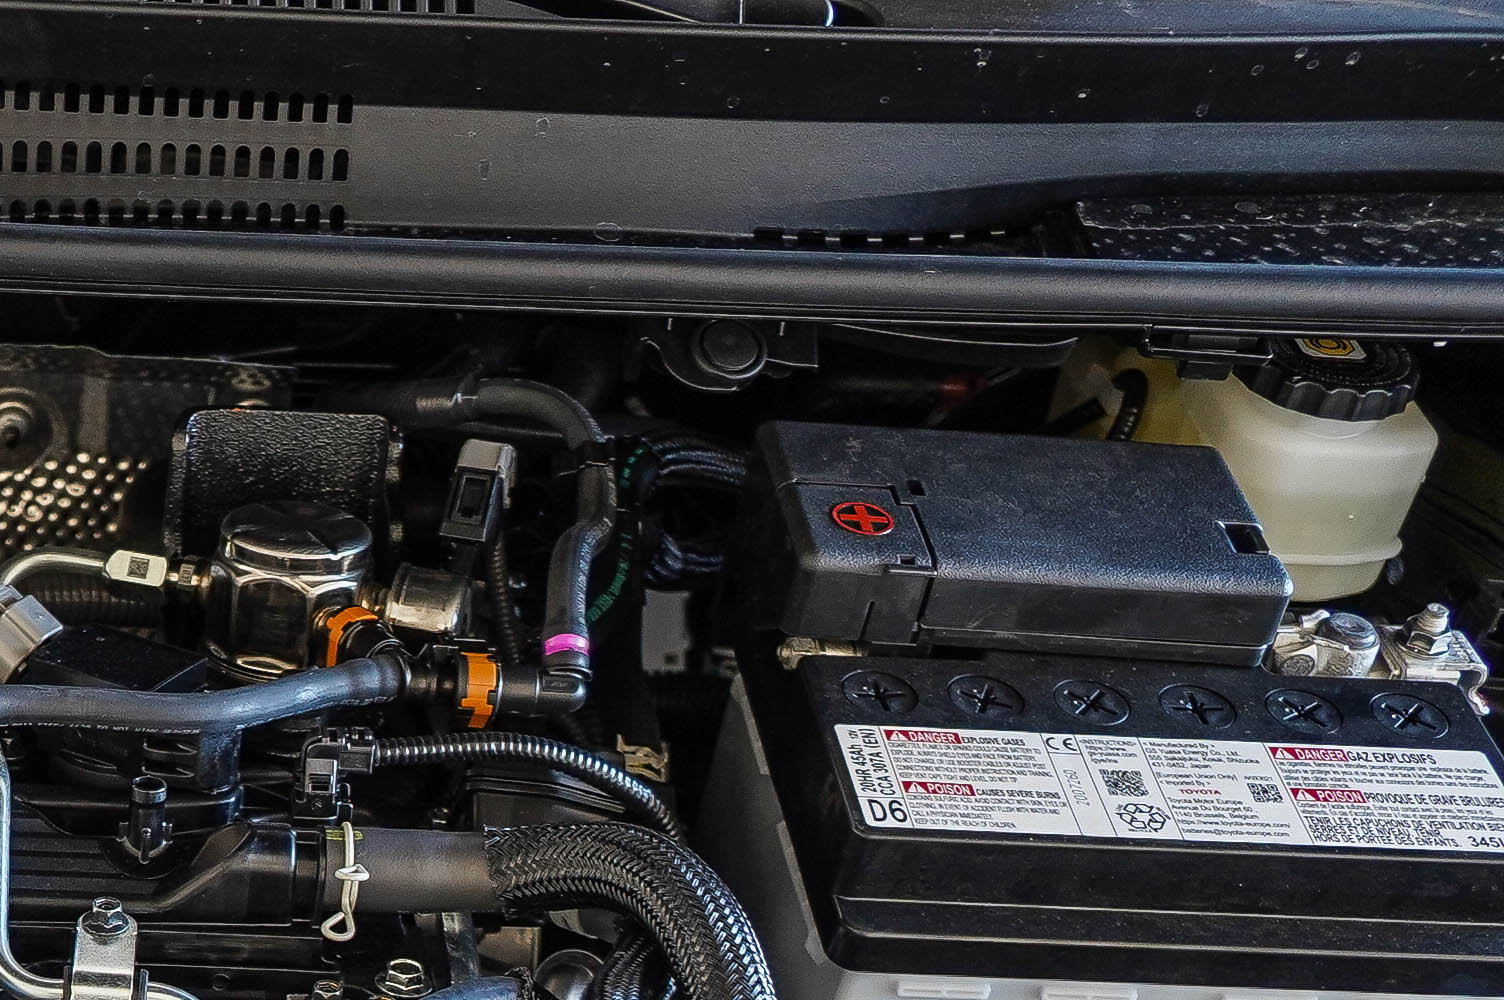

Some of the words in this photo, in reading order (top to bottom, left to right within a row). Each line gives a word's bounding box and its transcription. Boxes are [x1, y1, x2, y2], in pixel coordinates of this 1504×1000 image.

[858, 728, 881, 748] (EN)
[908, 732, 957, 742] DANGER
[847, 744, 868, 767] 45Ah
[1295, 749, 1346, 760] DANGER
[1346, 751, 1373, 761] GAZ
[1372, 752, 1437, 764] EXPLOSIFS
[867, 751, 889, 773] 307A
[855, 769, 876, 793] 20HR
[875, 775, 896, 796] CCA
[926, 783, 972, 795] POISON
[976, 788, 1006, 796] CAUSES
[1317, 791, 1363, 802] POISON
[1364, 792, 1415, 804] PROVOQUE
[1414, 794, 1430, 804] DE
[867, 799, 908, 823] D6
[1304, 816, 1332, 824] TENIR
[1333, 817, 1352, 825] LES
[1352, 818, 1411, 827] CAPUCHONS
[1411, 820, 1426, 828] DE
[1426, 821, 1487, 830] VENTILATION
[1347, 826, 1360, 834] ET
[1313, 833, 1340, 841] HORS
[1341, 834, 1355, 842] DE
